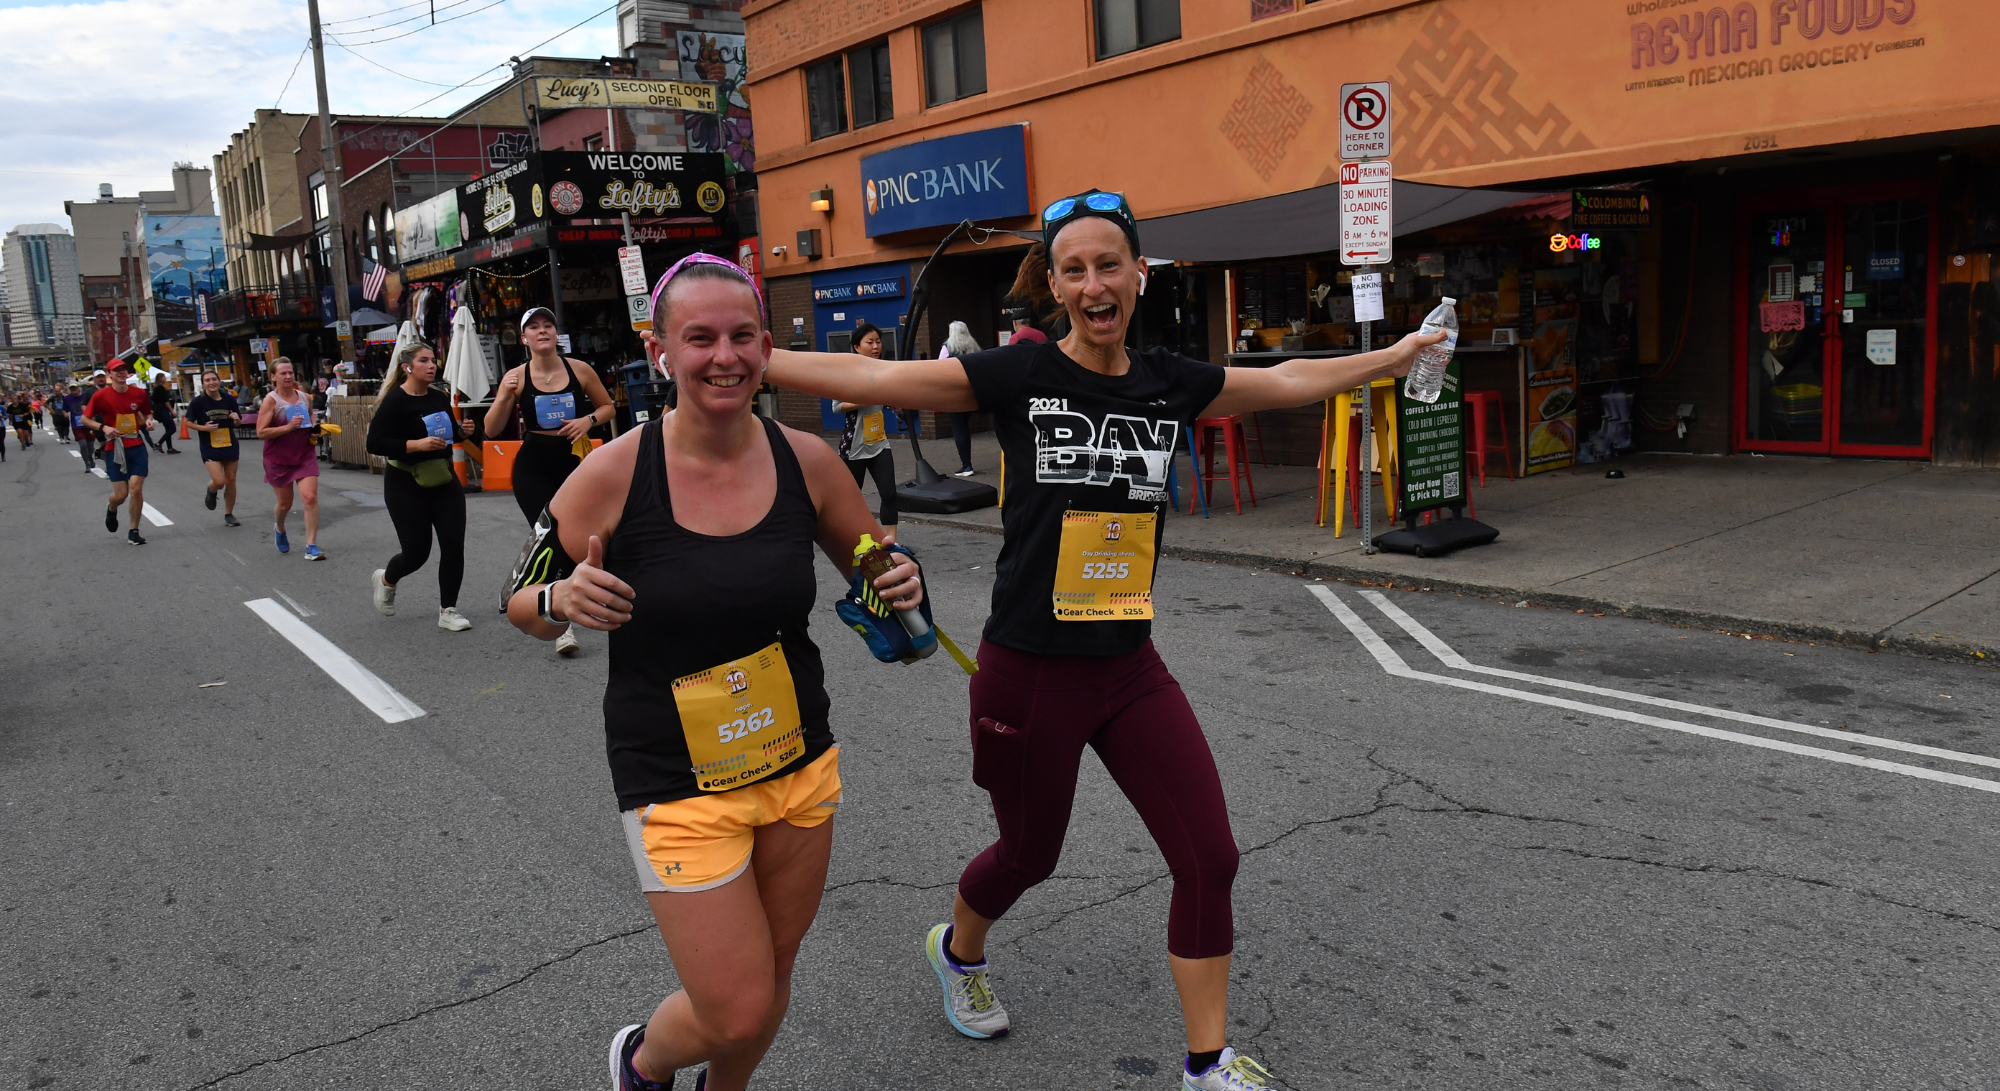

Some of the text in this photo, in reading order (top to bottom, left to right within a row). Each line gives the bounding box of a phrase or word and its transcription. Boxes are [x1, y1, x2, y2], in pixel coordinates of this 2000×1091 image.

[1626, 0, 1698, 16] Wholes
[1630, 0, 1916, 70] REYNA FOODS
[1625, 82, 1646, 91] LATIN
[1647, 76, 1684, 88] AMERICAN
[1688, 58, 1772, 86] MEXICAN
[1778, 40, 1874, 73] GROCERY
[542, 79, 710, 102] Lucy's SECOND FLOOR
[648, 94, 682, 107] OPEN
[1346, 132, 1370, 141] HERE
[1347, 142, 1384, 152] CORNER
[512, 159, 528, 175] ISLAND
[588, 155, 684, 171] WELCOME
[632, 171, 645, 179] TO
[1343, 166, 1389, 182] NO PARKING
[878, 158, 1005, 209] PNC BANK
[600, 180, 681, 215] Lefty's
[1343, 188, 1388, 200] 30 MINUTE
[556, 204, 578, 212] BEER
[1344, 203, 1387, 213] LOADING
[1588, 197, 1638, 209] COLOMBINO
[1353, 216, 1379, 226] ZONE
[1574, 214, 1588, 225] FINE
[1589, 214, 1611, 224] COFFEE
[1618, 214, 1637, 224] CACAO
[1638, 214, 1650, 224] BAR
[1766, 217, 1807, 233] 2031
[558, 230, 585, 241] CHEAP
[589, 230, 619, 240] DRINKS
[667, 228, 692, 238] CHEAP
[694, 226, 722, 237] DRINKS
[1344, 231, 1350, 239] 8
[1371, 230, 1376, 238] 6
[1567, 233, 1600, 250] Coffee
[1870, 258, 1900, 266] CLOSED
[820, 287, 851, 299] PNC BANK
[864, 282, 897, 295] PNC BANK
[1029, 398, 1068, 411] 2021
[1405, 405, 1424, 416] COFFEE
[1431, 402, 1447, 412] CACAO
[1448, 401, 1459, 409] BAR
[1408, 414, 1458, 430] COLD BREW ESPRESSO
[1029, 411, 1178, 492] BAY
[1408, 479, 1440, 492] Order Now
[1128, 489, 1170, 504] BRIDGER
[1410, 489, 1440, 502] & Pick Up
[1082, 562, 1130, 579] 5255
[1063, 608, 1087, 617] Gear
[1089, 608, 1115, 616] Check
[718, 707, 775, 744] 5262
[779, 746, 798, 763] 5262
[712, 762, 772, 787] Gear Check
